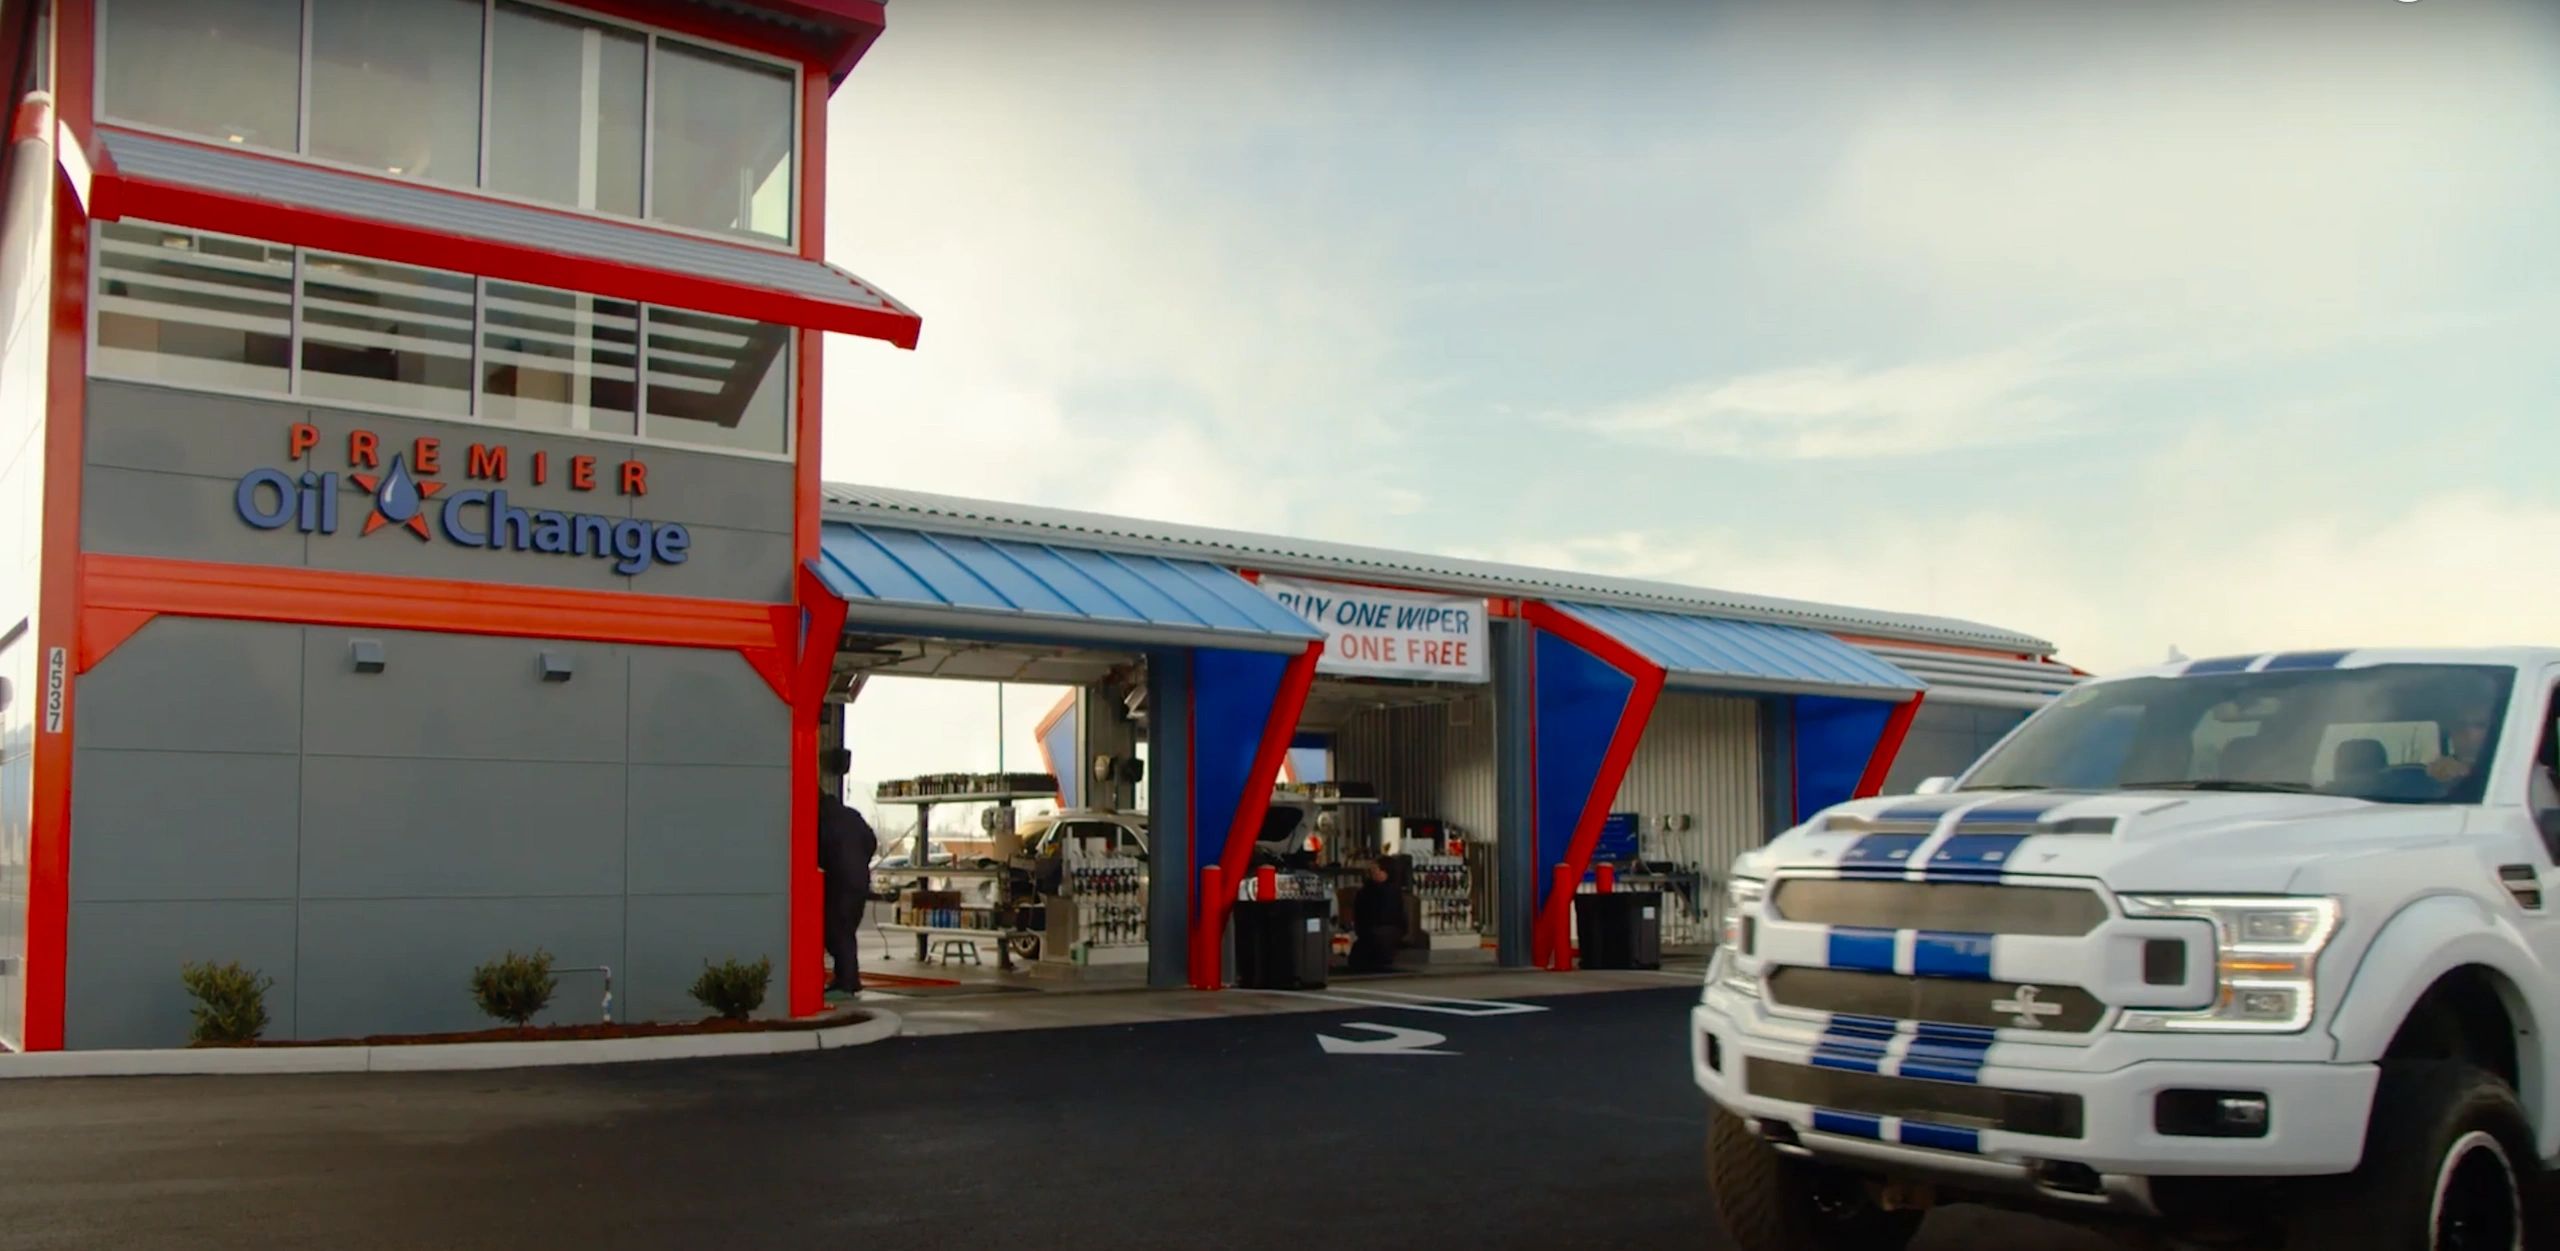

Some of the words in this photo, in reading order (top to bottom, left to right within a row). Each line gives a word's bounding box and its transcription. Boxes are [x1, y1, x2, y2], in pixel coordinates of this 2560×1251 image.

[291, 423, 648, 496] PREMIER
[236, 467, 339, 534] Oil
[442, 489, 690, 575] Change
[1336, 600, 1391, 629] ONE
[1397, 606, 1469, 635] WIPER
[1340, 633, 1397, 662] ONE
[1407, 638, 1468, 667] FREE
[49, 648, 64, 732] 4537
